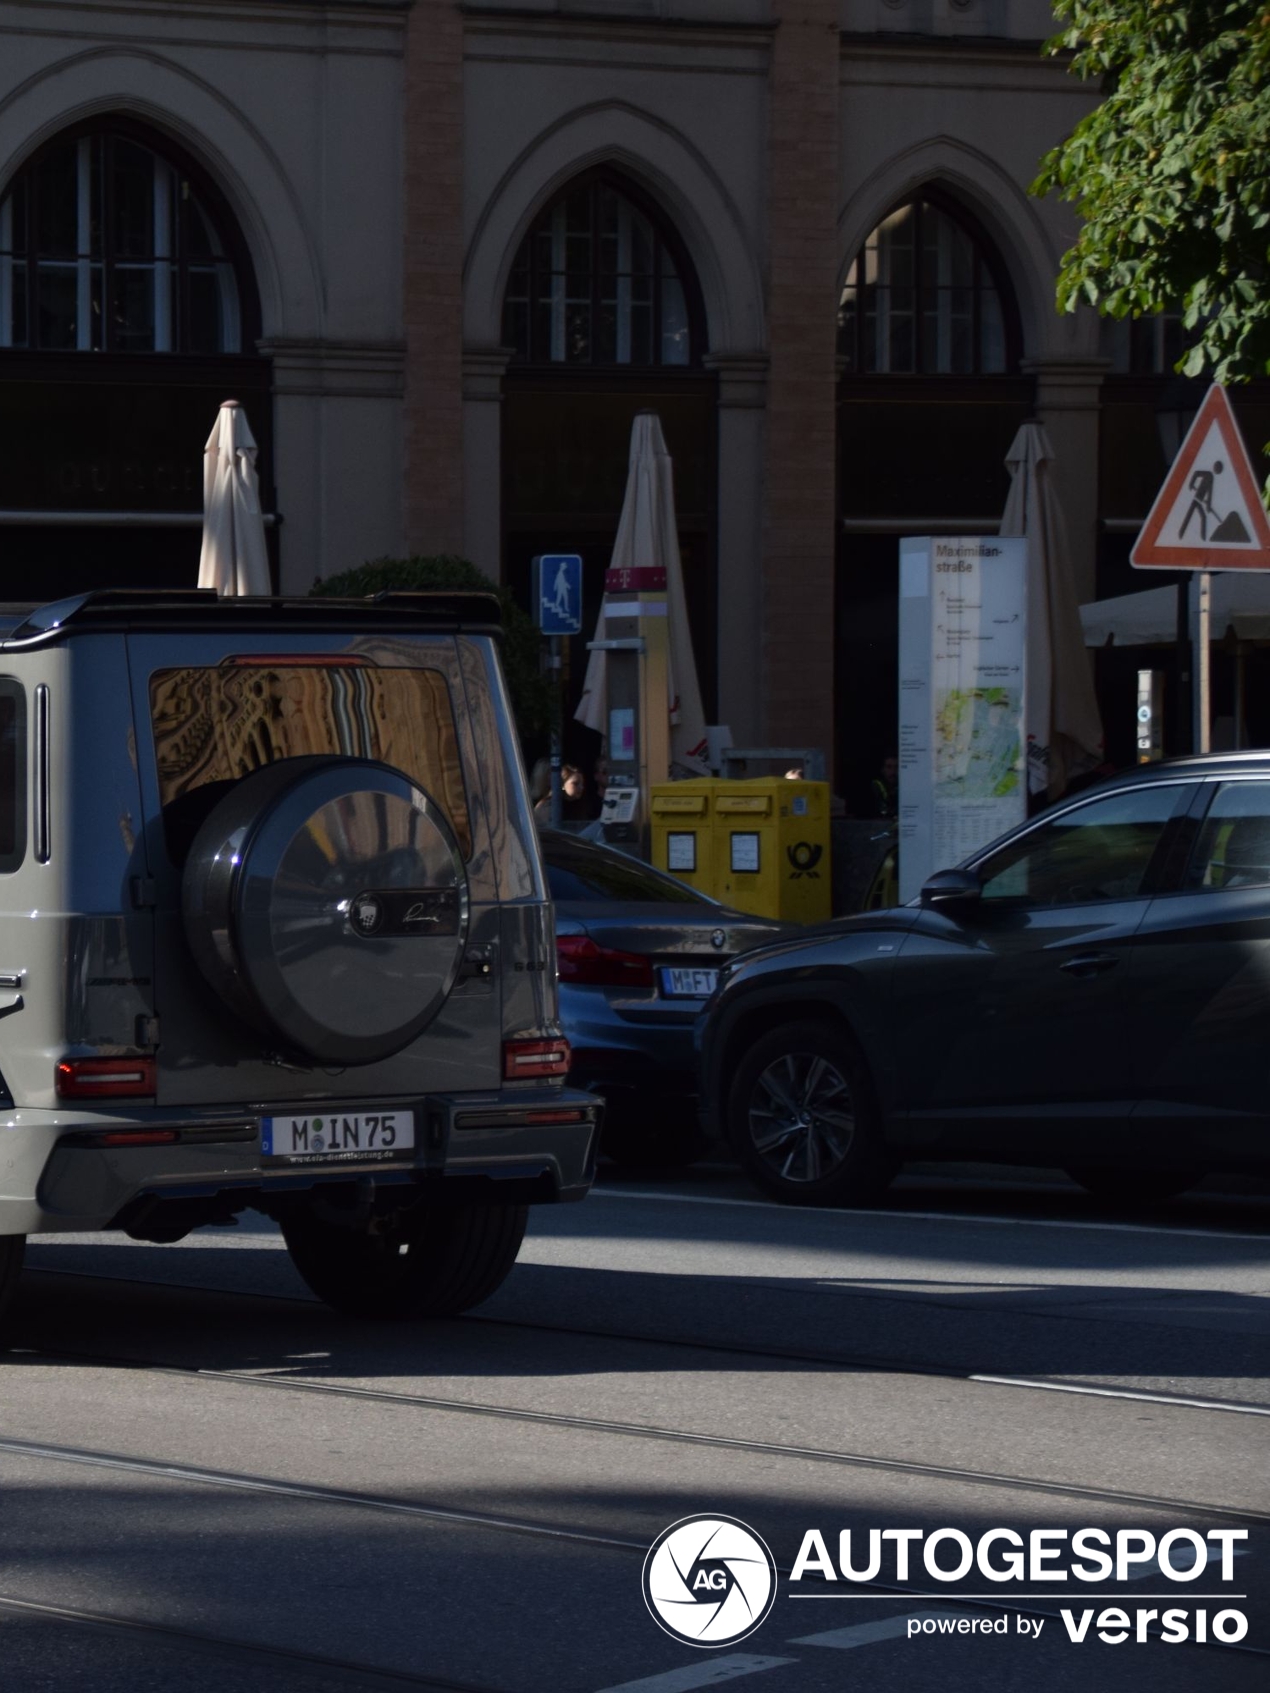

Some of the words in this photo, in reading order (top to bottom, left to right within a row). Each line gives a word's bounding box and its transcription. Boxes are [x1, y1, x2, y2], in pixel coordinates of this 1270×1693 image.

[936, 545, 1003, 557] Maximilian-
[936, 561, 973, 573] straße
[292, 1120, 308, 1151] M
[328, 1118, 360, 1149] IN
[365, 1116, 396, 1147] 75
